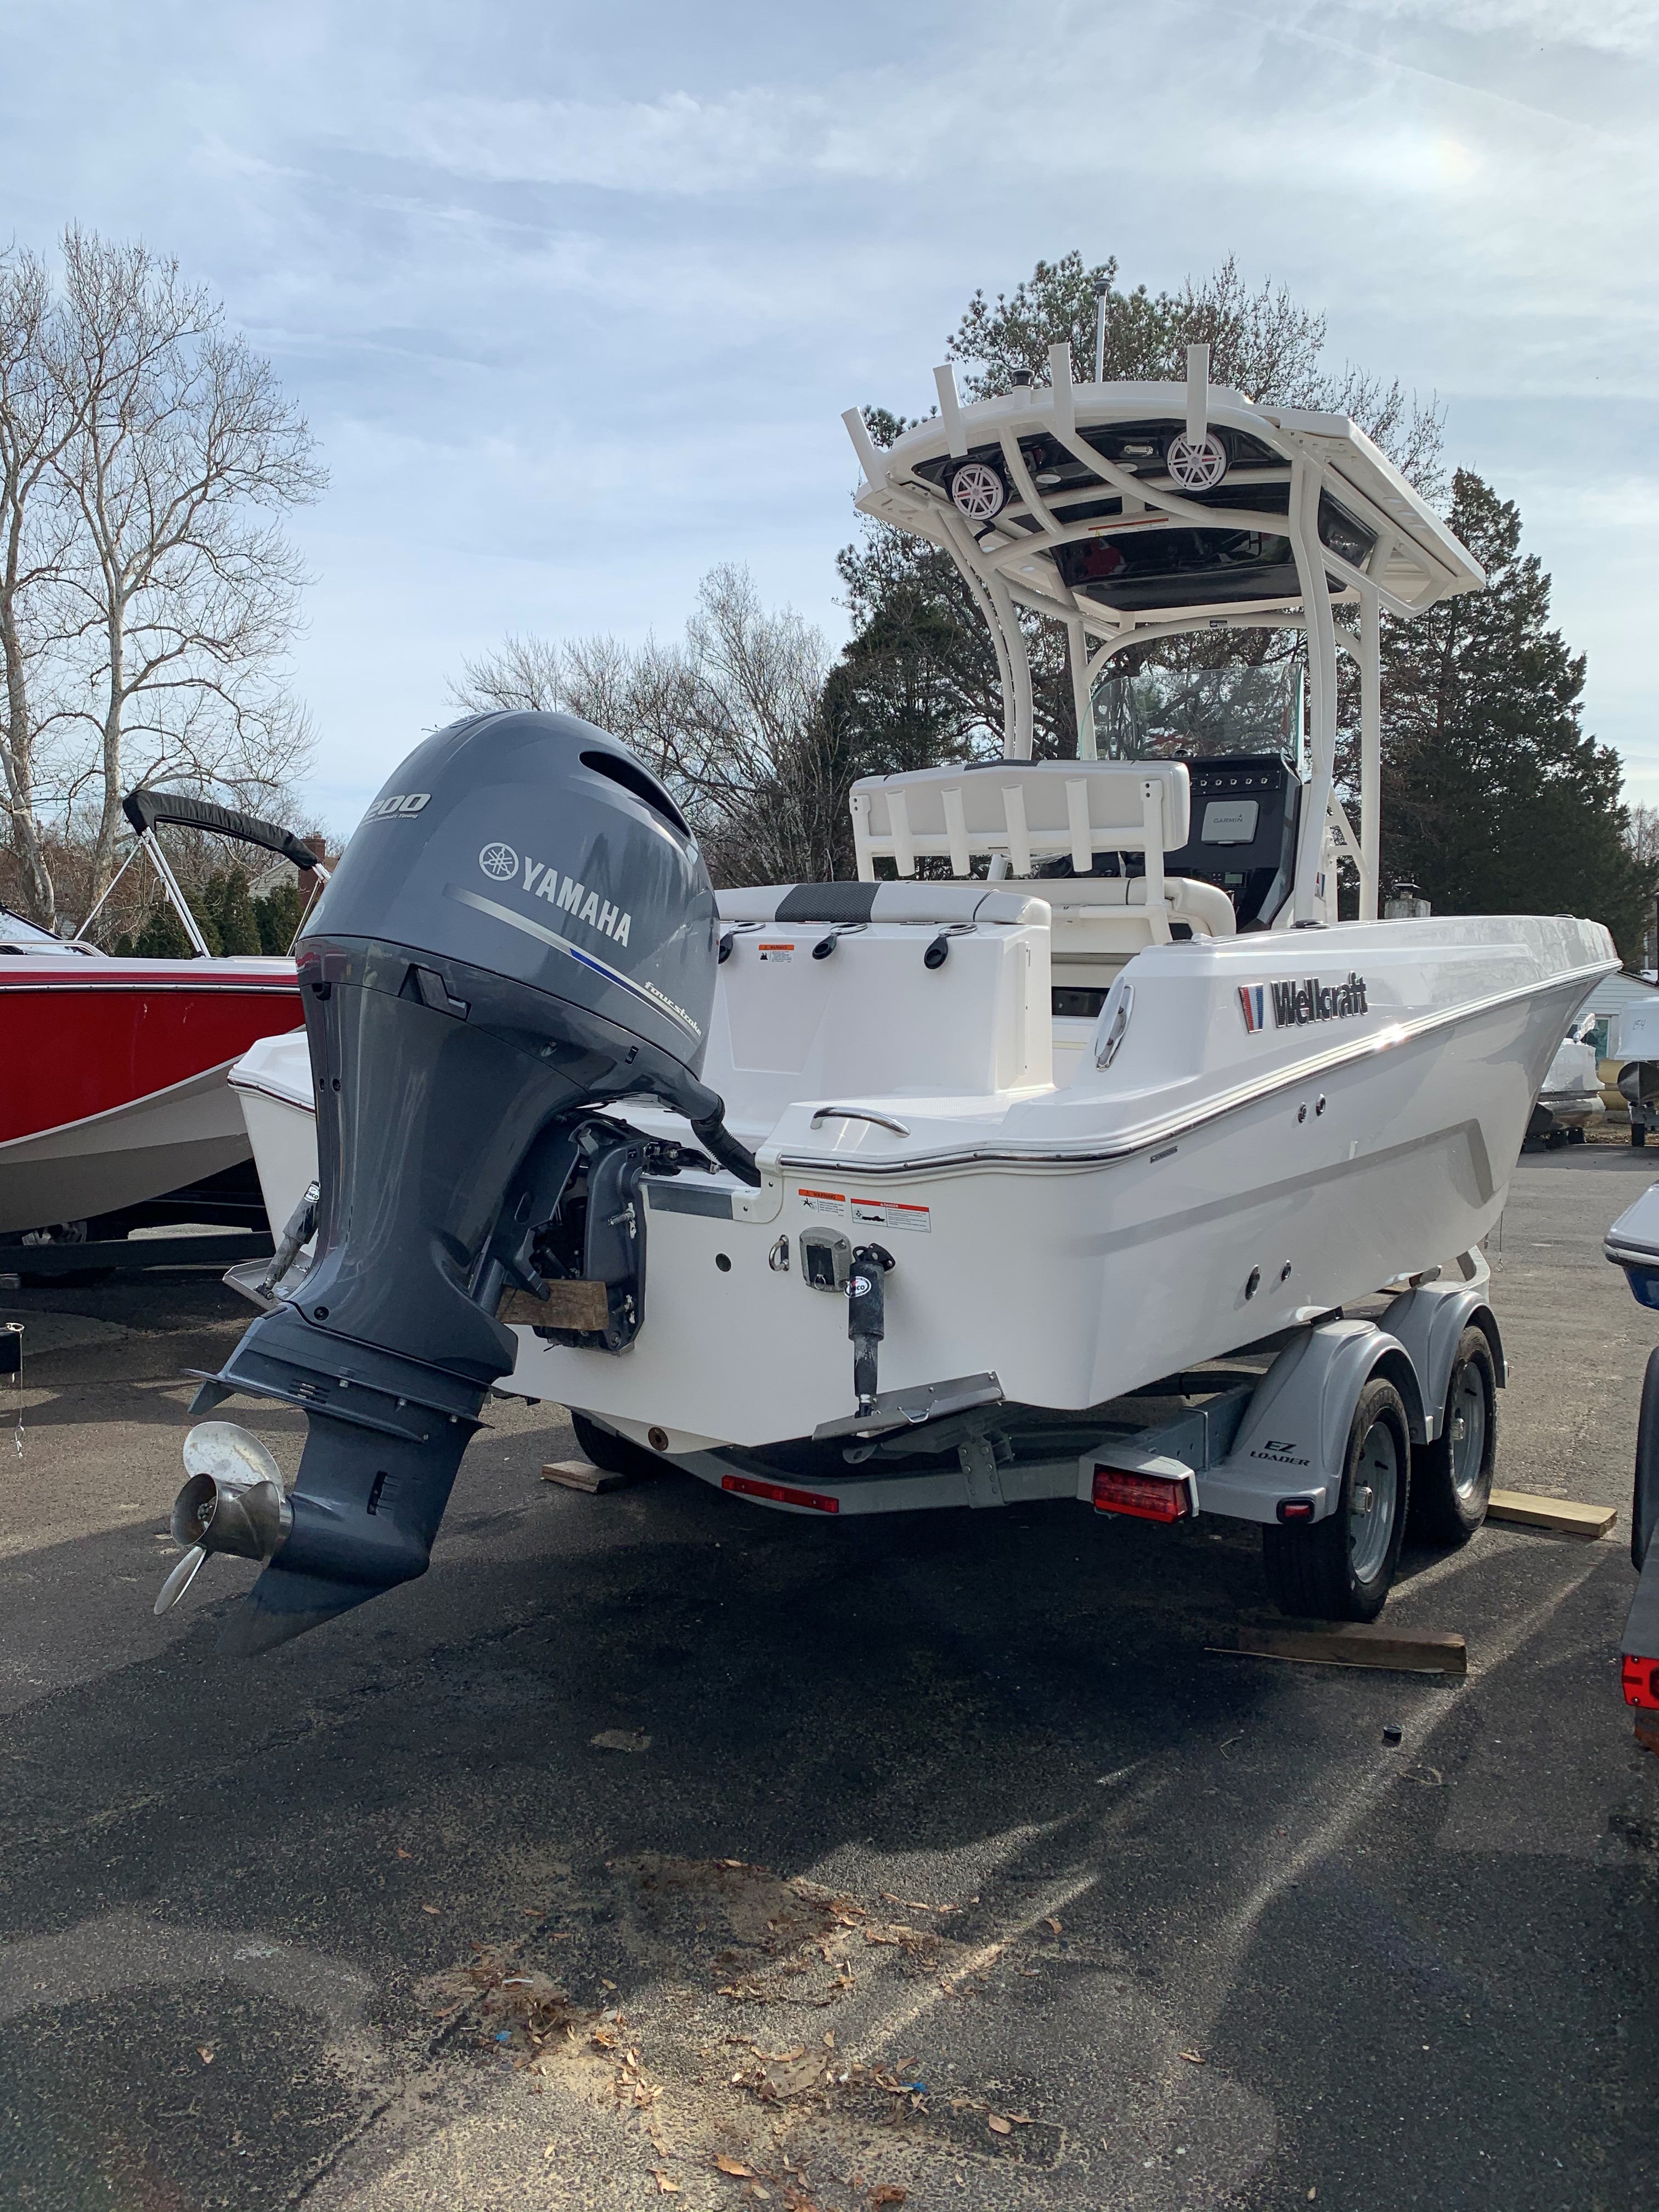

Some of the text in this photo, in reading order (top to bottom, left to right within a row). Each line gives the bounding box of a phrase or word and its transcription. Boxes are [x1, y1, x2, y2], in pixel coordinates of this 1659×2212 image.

[522, 856, 631, 948] YAMAHA
[1271, 970, 1368, 1028] Wellcraft
[1250, 1451, 1310, 1466] LOADER
[1263, 1441, 1297, 1454] EZ
